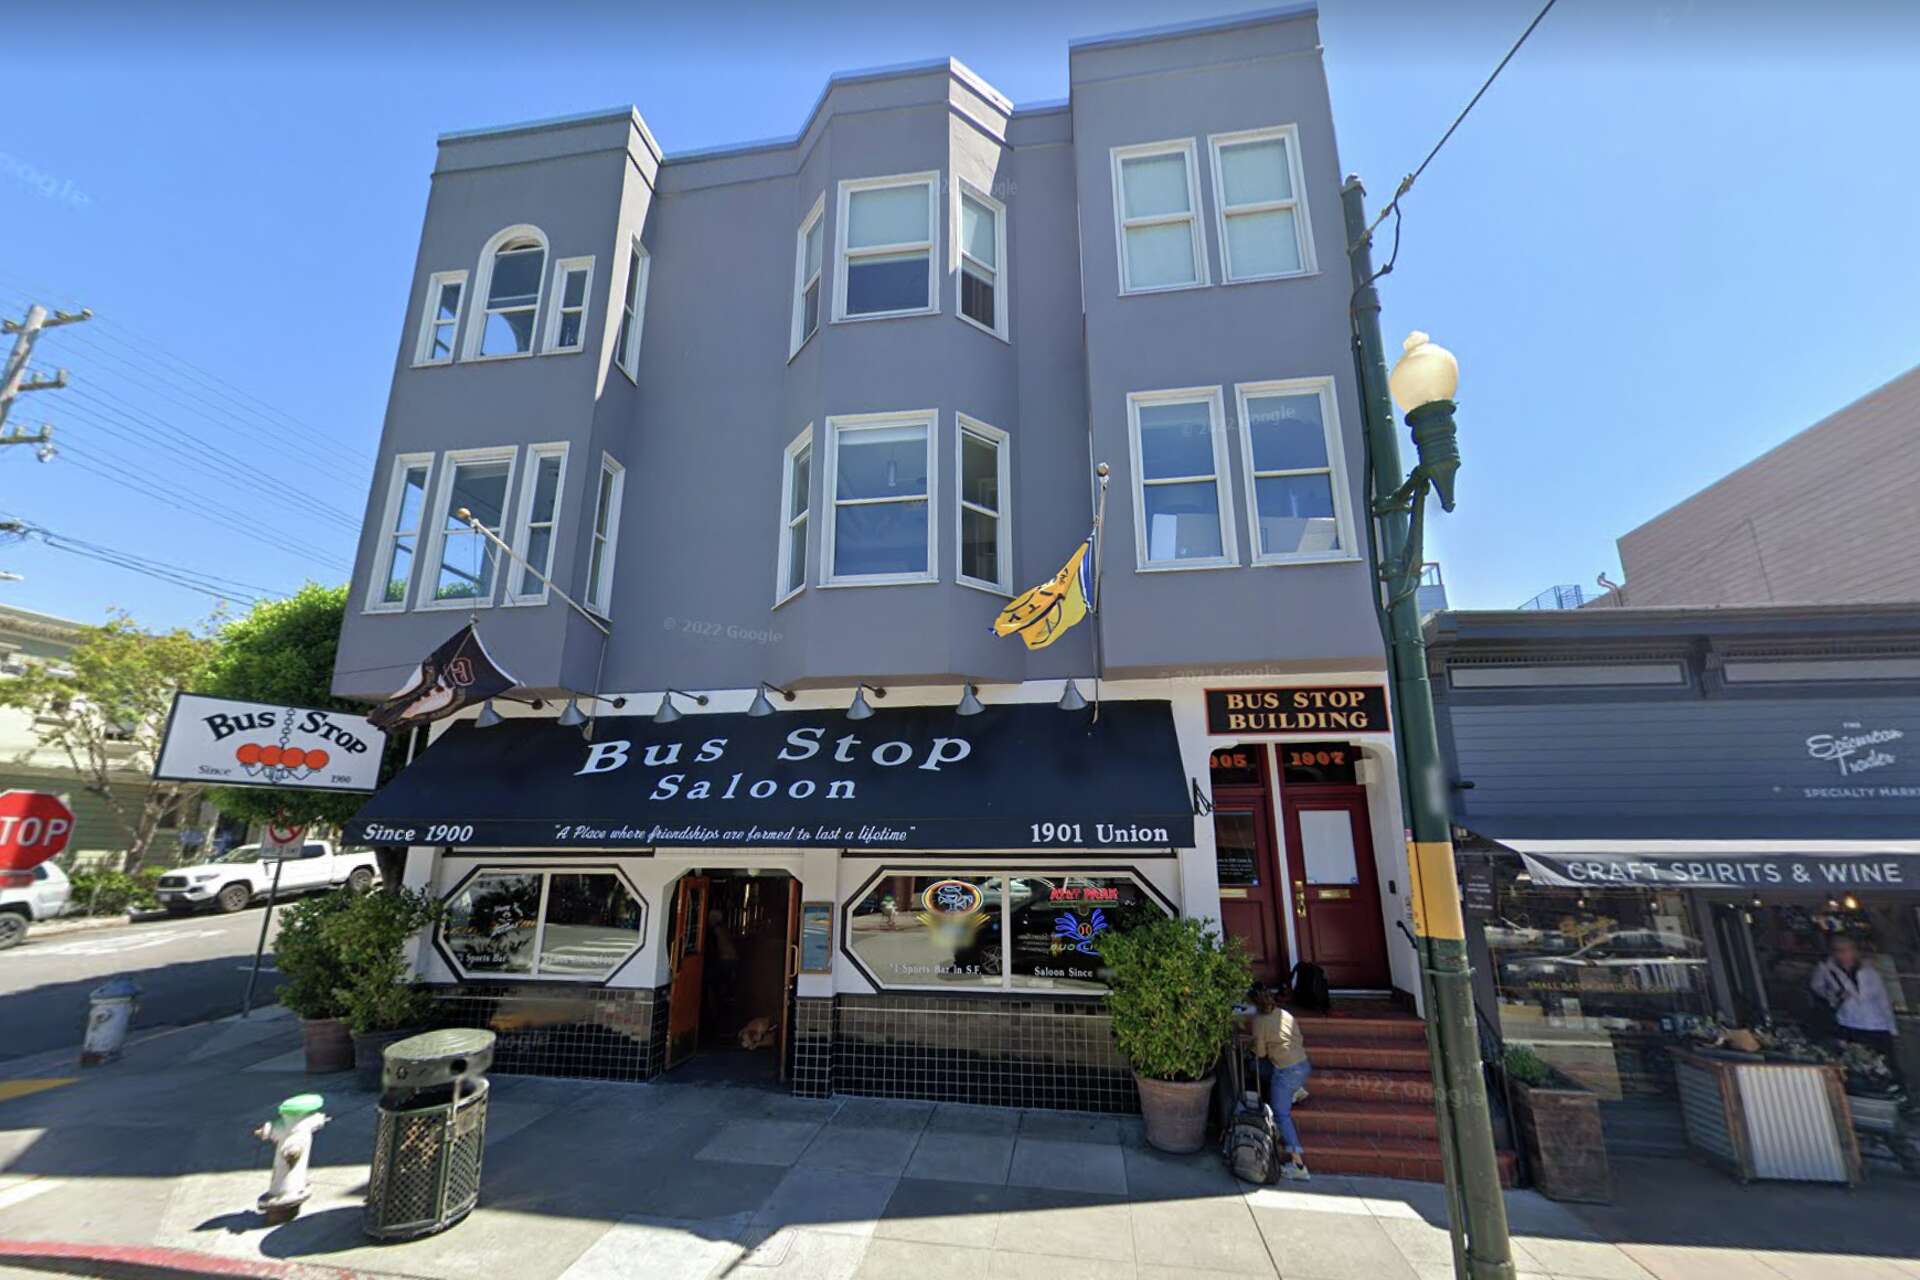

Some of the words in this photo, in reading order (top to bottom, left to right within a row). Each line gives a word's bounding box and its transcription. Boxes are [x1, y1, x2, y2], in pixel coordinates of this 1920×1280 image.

[1226, 692, 1280, 710] BUS
[1293, 691, 1366, 709] STOP
[1228, 711, 1369, 730] BUILDING
[573, 738, 729, 776] Bus
[777, 727, 972, 772] Stop
[1209, 754, 1247, 768] 905
[1290, 751, 1345, 768] 1907
[199, 764, 232, 777] Since
[649, 772, 857, 800] Saloon
[1804, 787, 1875, 798] SPECIALTY
[1880, 786, 1920, 797] MARK
[0, 815, 69, 847] TOP
[362, 823, 417, 841] Since
[424, 823, 474, 842] 1900
[573, 824, 607, 840] Place
[609, 824, 646, 840] where
[647, 824, 720, 844] friendships
[722, 830, 743, 840] are
[745, 824, 796, 843] formed
[797, 827, 812, 841] to
[815, 825, 842, 841] last
[844, 831, 854, 840] a
[1031, 822, 1083, 843] 1901
[1096, 823, 1169, 843] Union
[1567, 861, 1658, 881] CRAFT
[1670, 862, 1782, 883] SPIRITS
[1791, 863, 1812, 883] &
[1818, 863, 1903, 883] WINE
[466, 952, 491, 968] Sports
[902, 963, 930, 975] Sports
[934, 964, 950, 974] Bar
[1034, 965, 1065, 977] Saloon
[1068, 967, 1093, 978] Since
